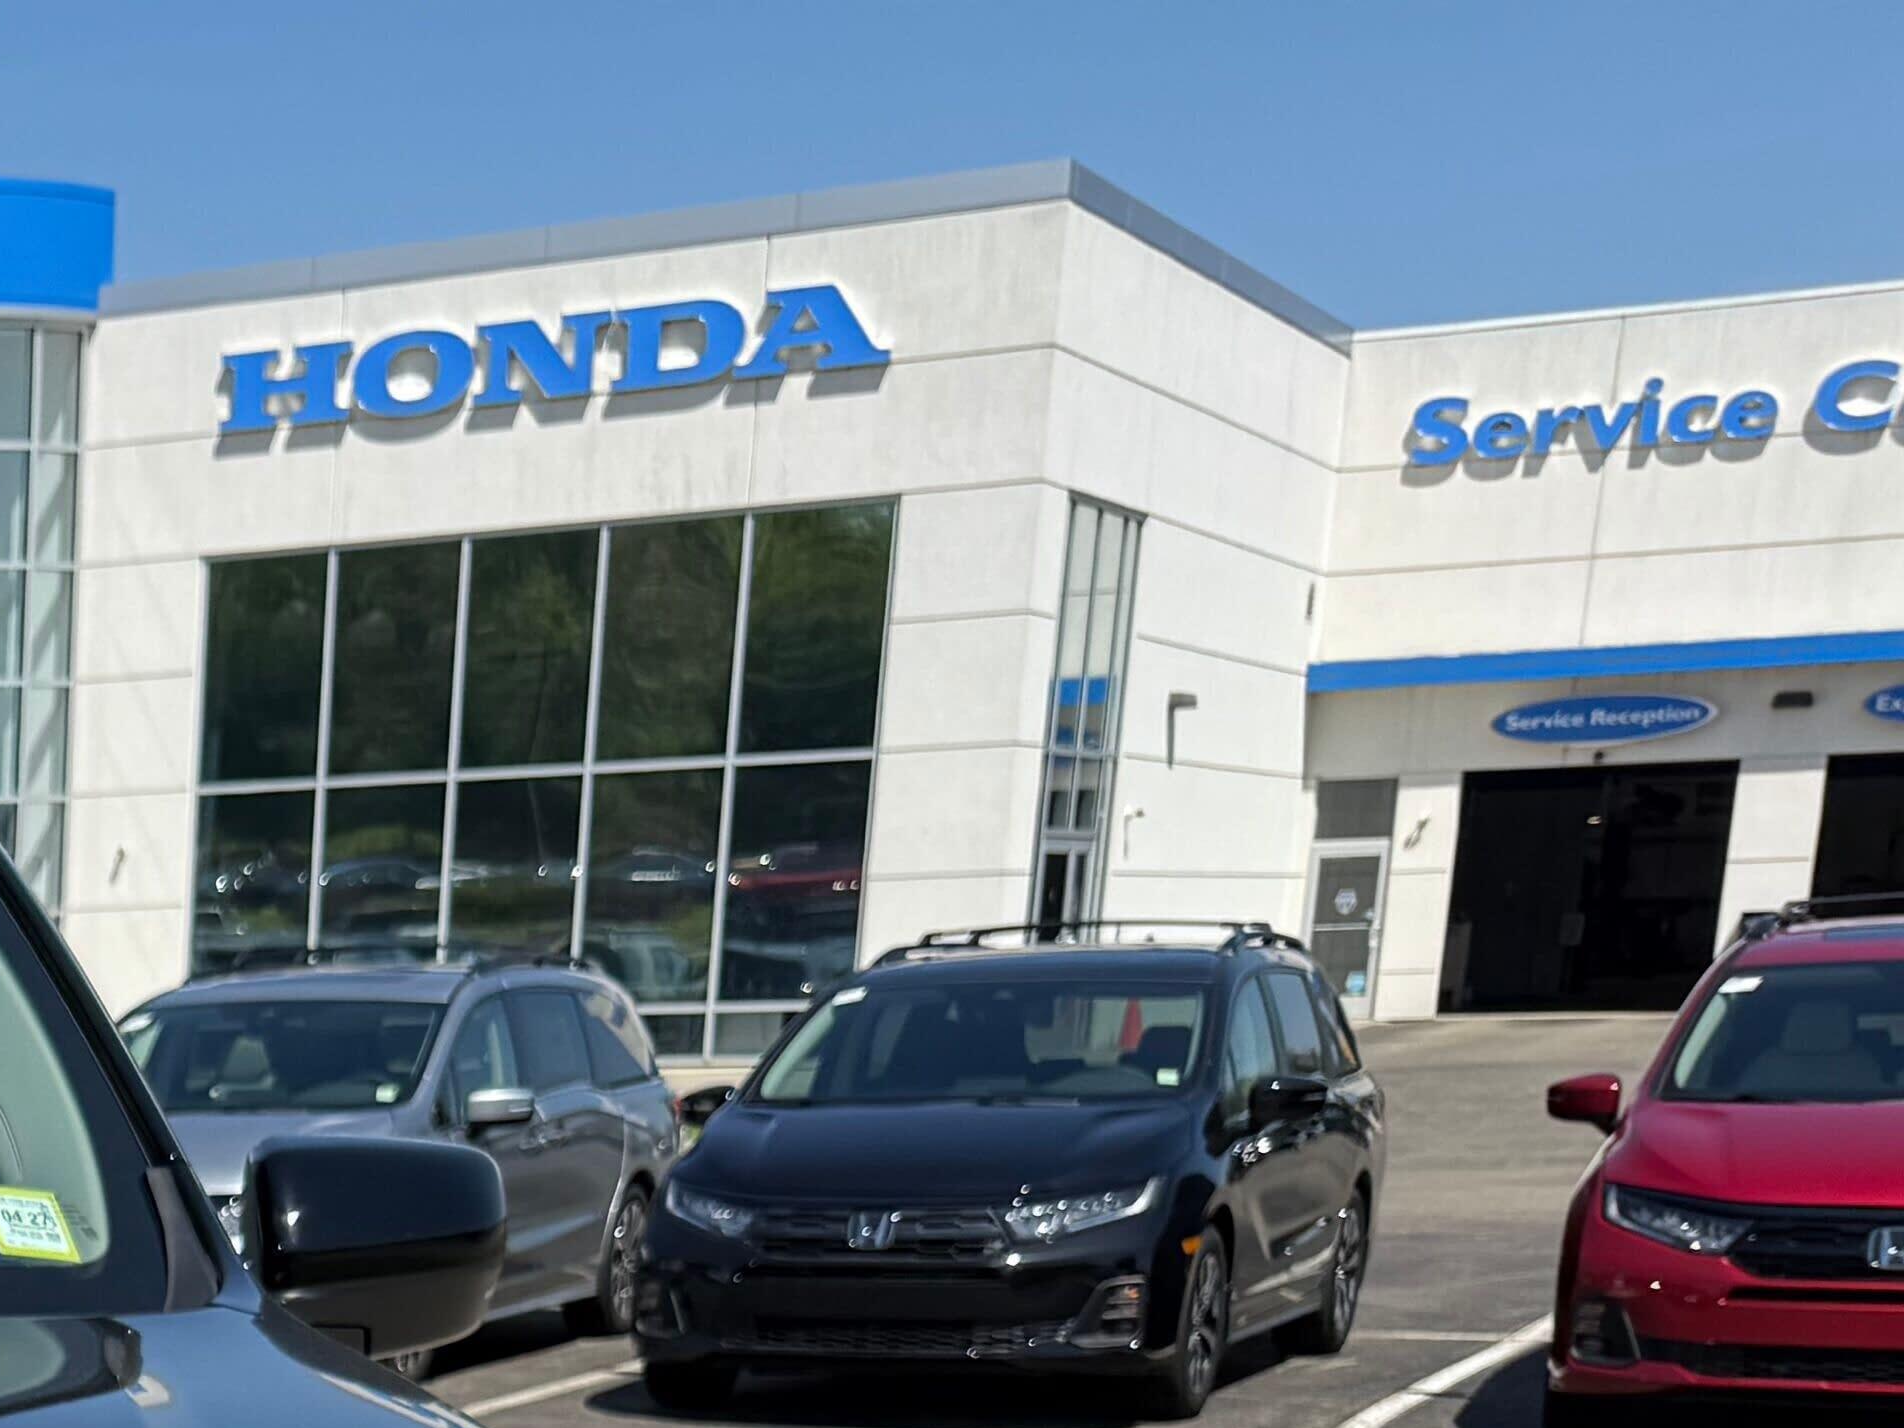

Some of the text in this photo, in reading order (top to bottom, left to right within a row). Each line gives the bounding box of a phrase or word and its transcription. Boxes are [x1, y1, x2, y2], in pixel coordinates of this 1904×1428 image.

[220, 284, 892, 432] HONDA
[1409, 377, 1779, 466] Service
[1505, 706, 1700, 731] Service Reception
